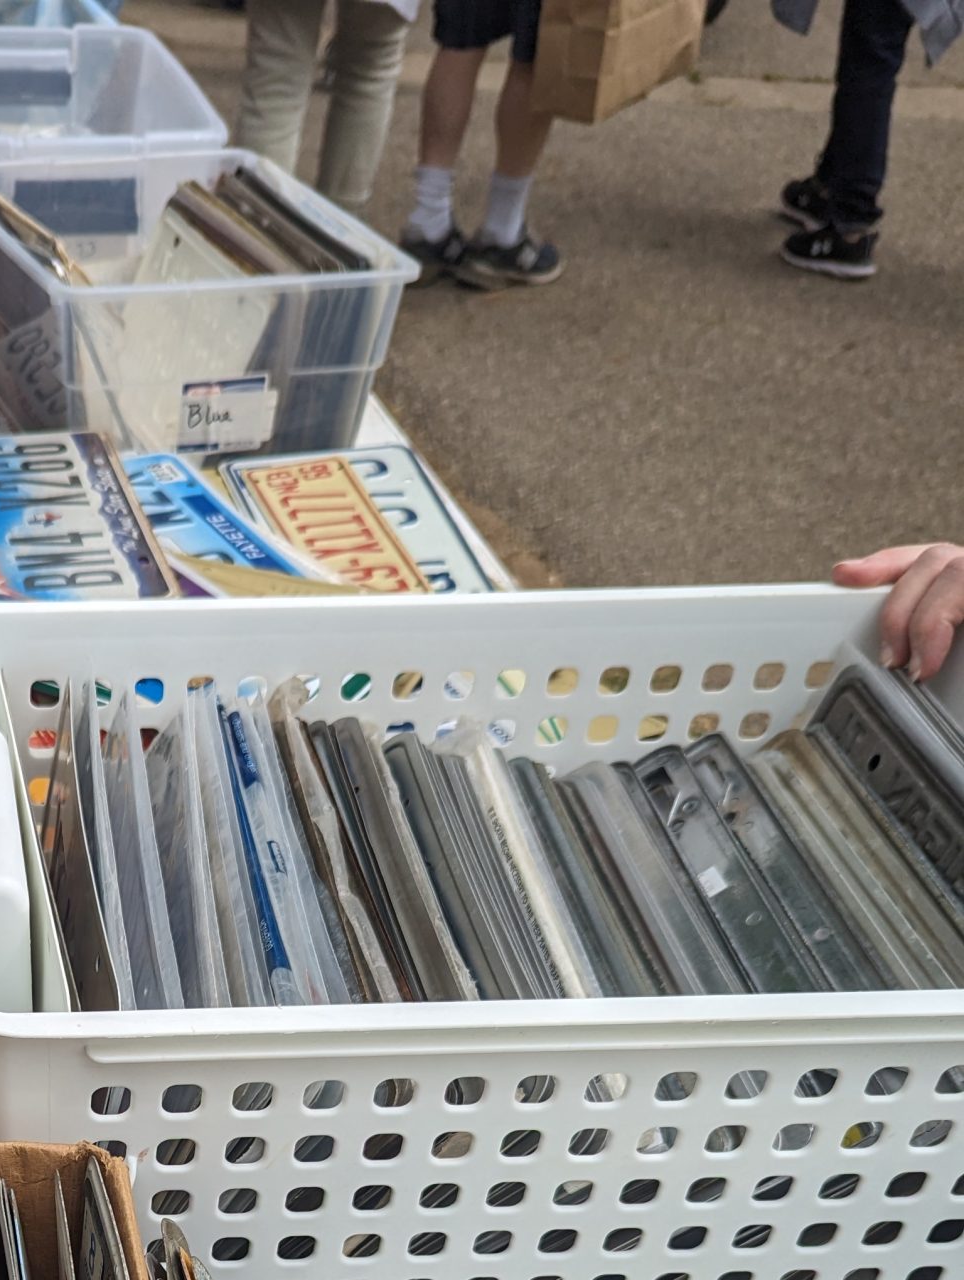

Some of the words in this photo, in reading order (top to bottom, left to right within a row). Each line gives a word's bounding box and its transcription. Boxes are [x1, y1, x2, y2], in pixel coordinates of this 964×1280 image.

[187, 402, 233, 428] Blue
[8, 530, 124, 591] BM4
[205, 513, 266, 562] FAYETTE
